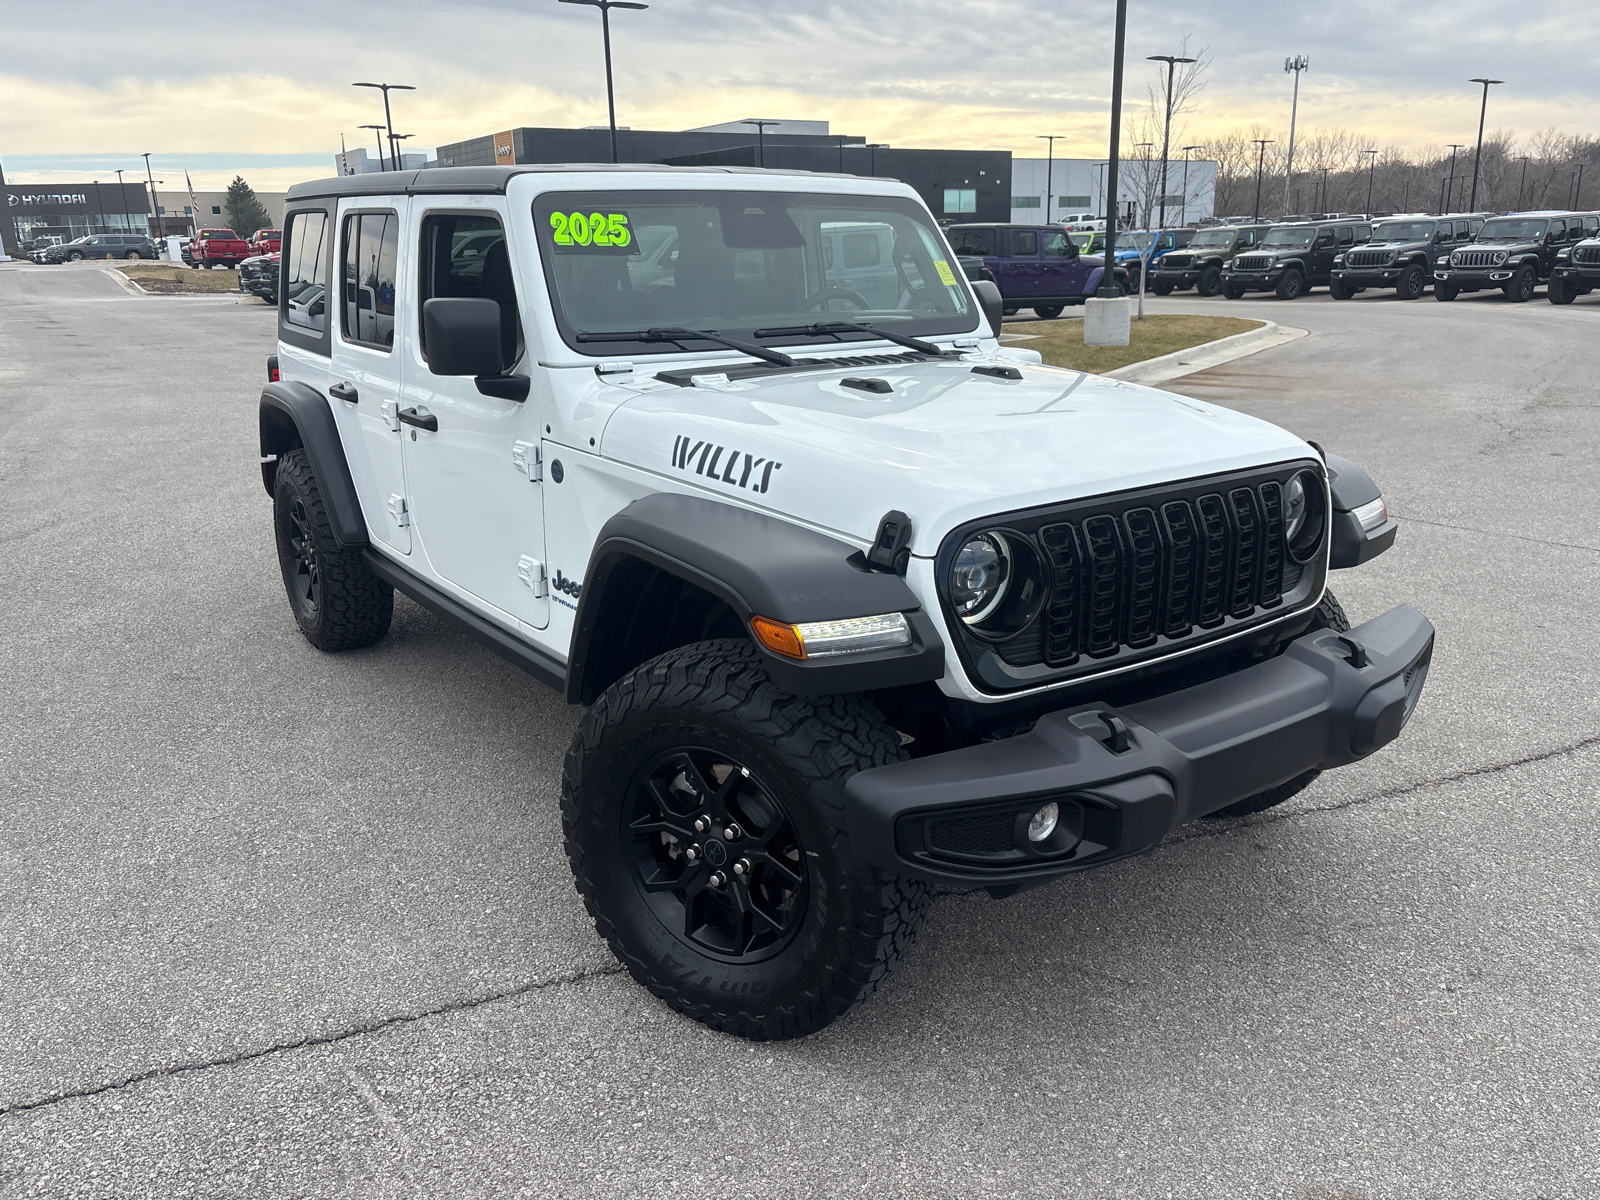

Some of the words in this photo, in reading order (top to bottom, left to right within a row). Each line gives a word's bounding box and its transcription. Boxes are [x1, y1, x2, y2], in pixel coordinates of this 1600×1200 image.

[22, 194, 87, 205] HYUNDAI
[550, 212, 631, 248] 2025
[672, 434, 783, 494] WILLYS
